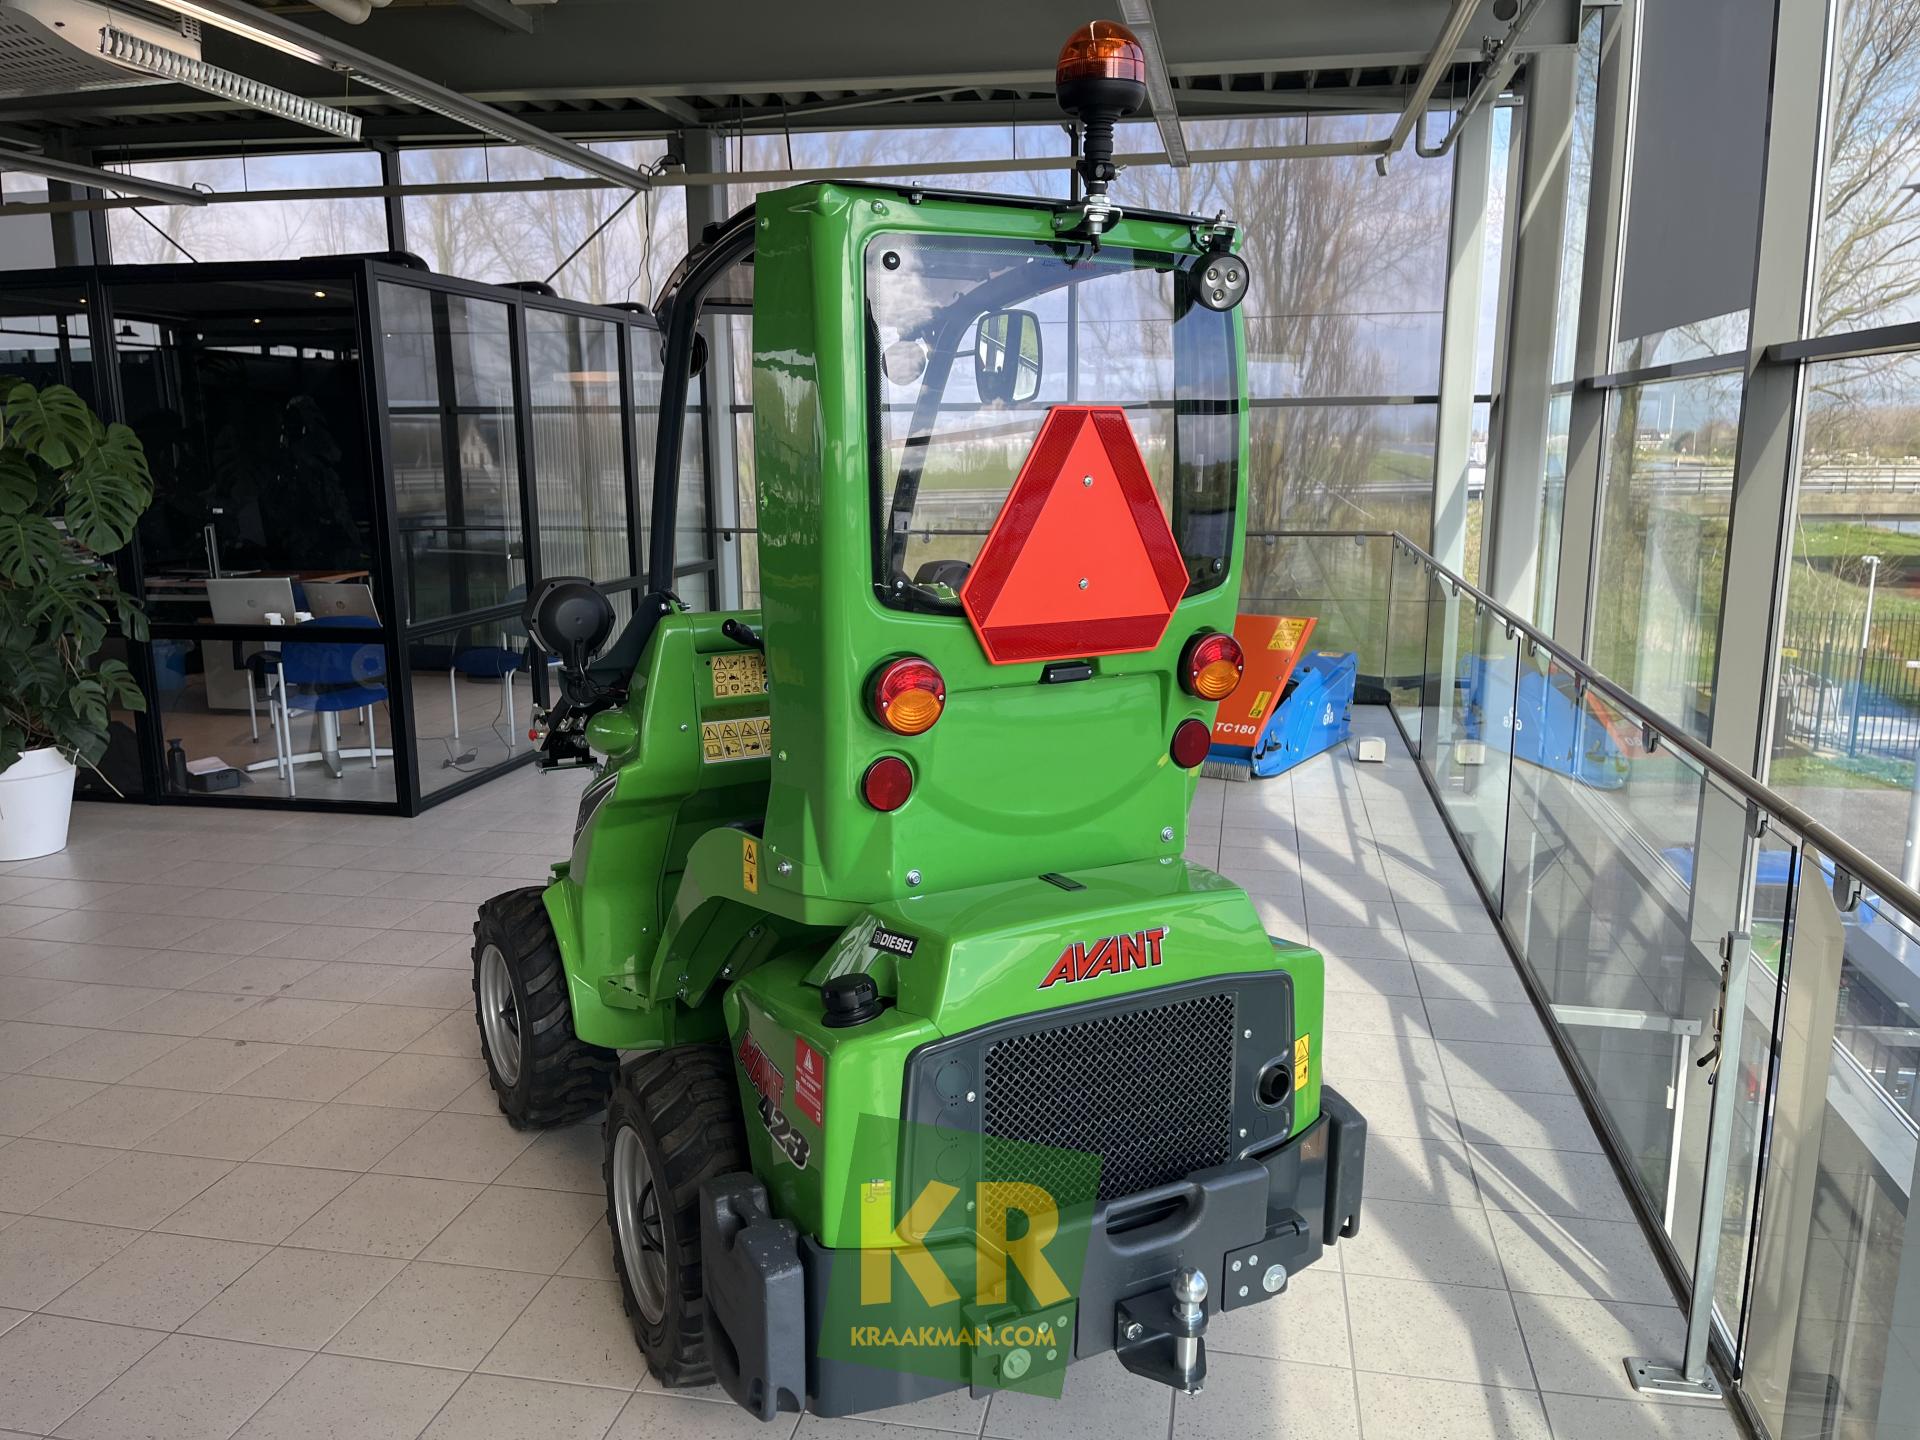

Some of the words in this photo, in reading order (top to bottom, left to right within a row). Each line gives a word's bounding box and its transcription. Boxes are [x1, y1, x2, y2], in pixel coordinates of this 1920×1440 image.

[1216, 722, 1256, 735] TC180
[880, 933, 914, 954] DIESEL
[1037, 927, 1165, 990] AVANT
[737, 1029, 784, 1110] AVANT
[758, 1095, 811, 1171] 423
